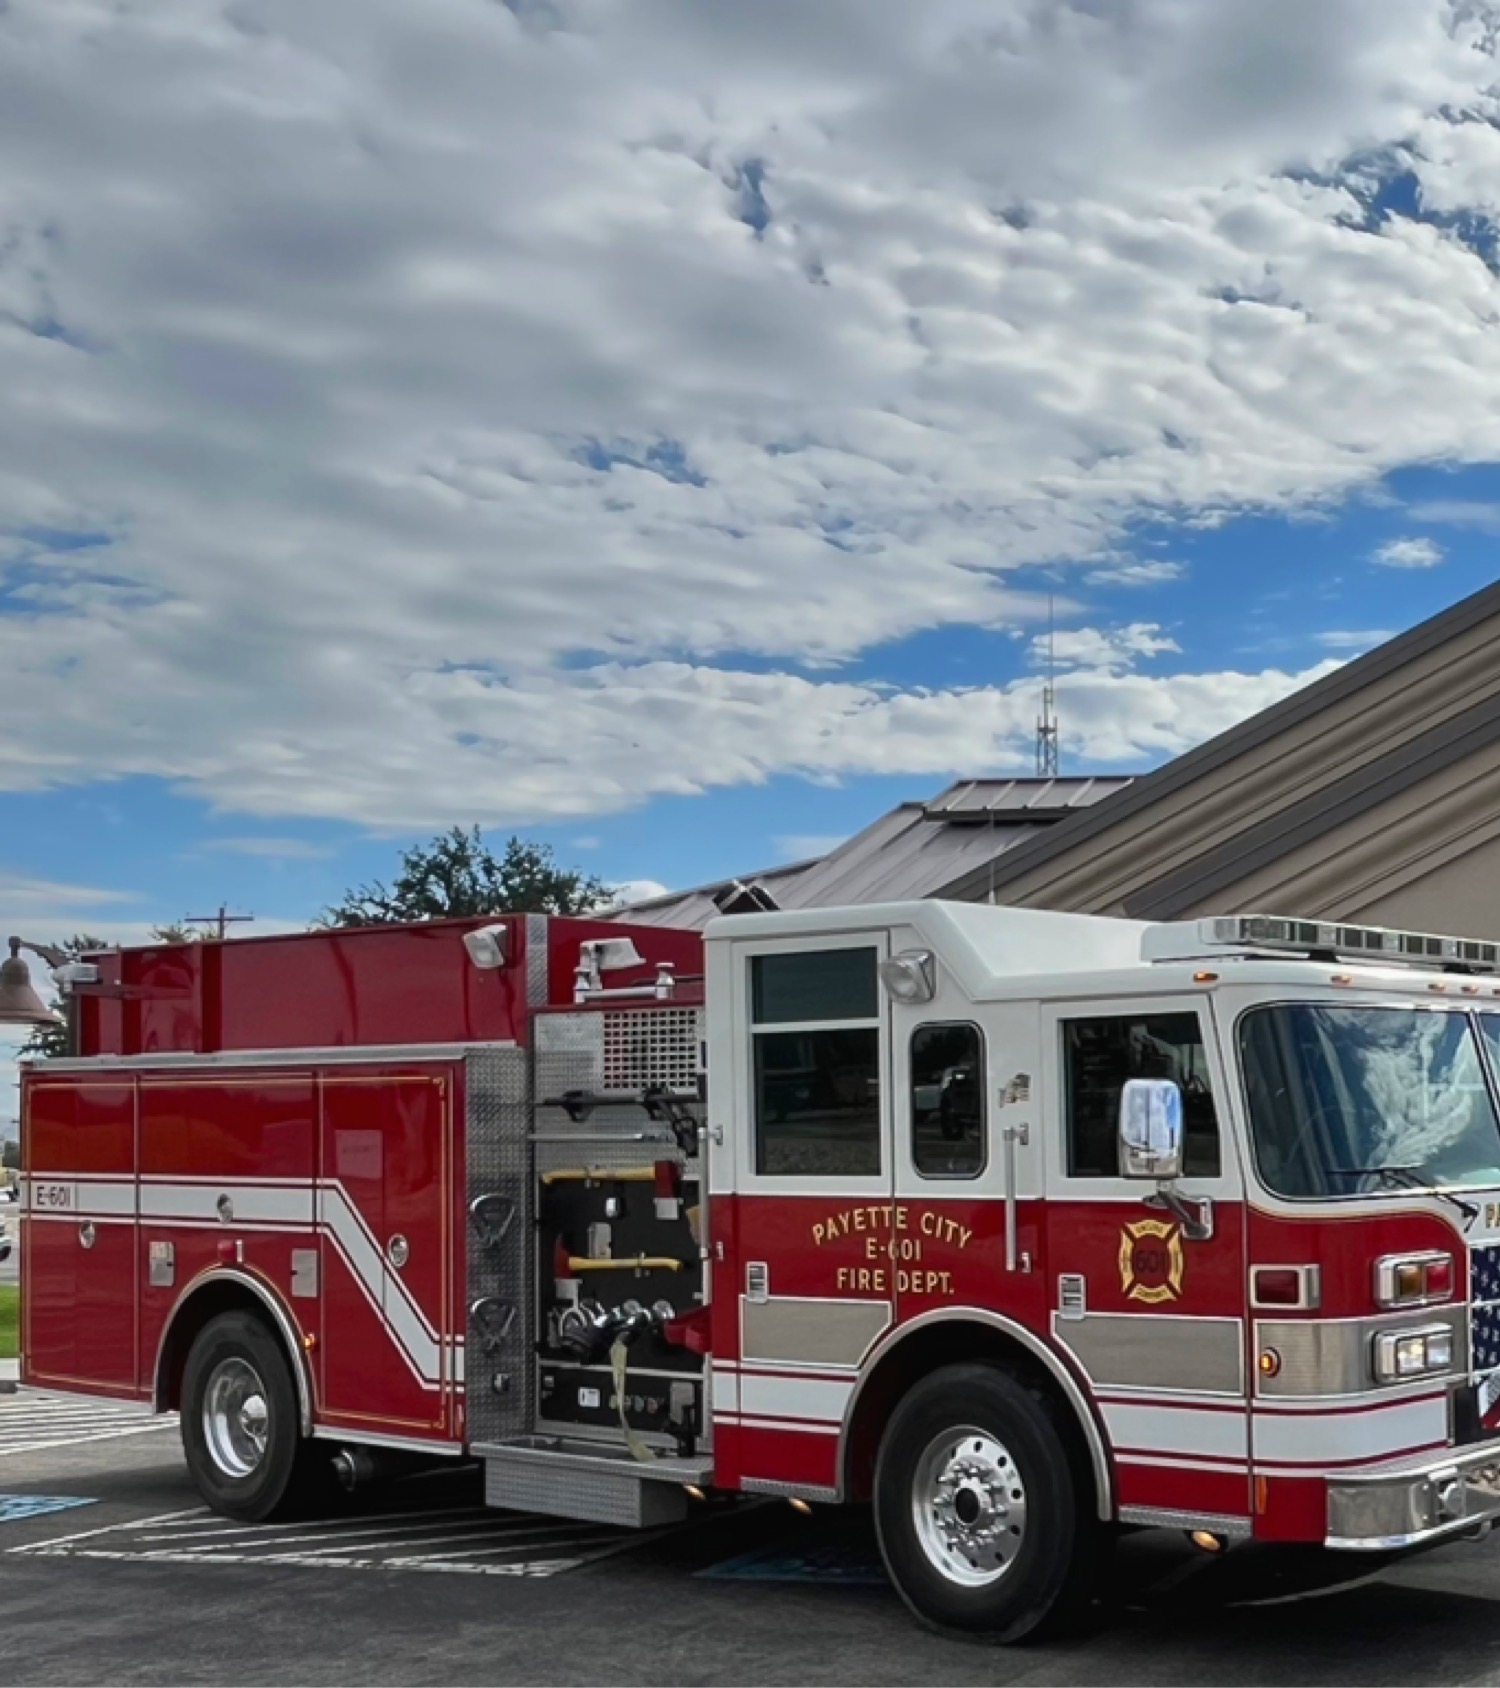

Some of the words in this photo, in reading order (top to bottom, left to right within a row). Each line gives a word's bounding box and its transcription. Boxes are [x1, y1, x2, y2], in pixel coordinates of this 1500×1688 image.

[36, 1186, 71, 1206] E-601
[812, 1206, 908, 1246] PAYETTE
[920, 1211, 972, 1248] CITY
[865, 1237, 922, 1261] E-601
[837, 1267, 886, 1291] FIRE
[898, 1270, 955, 1295] DEPT.
